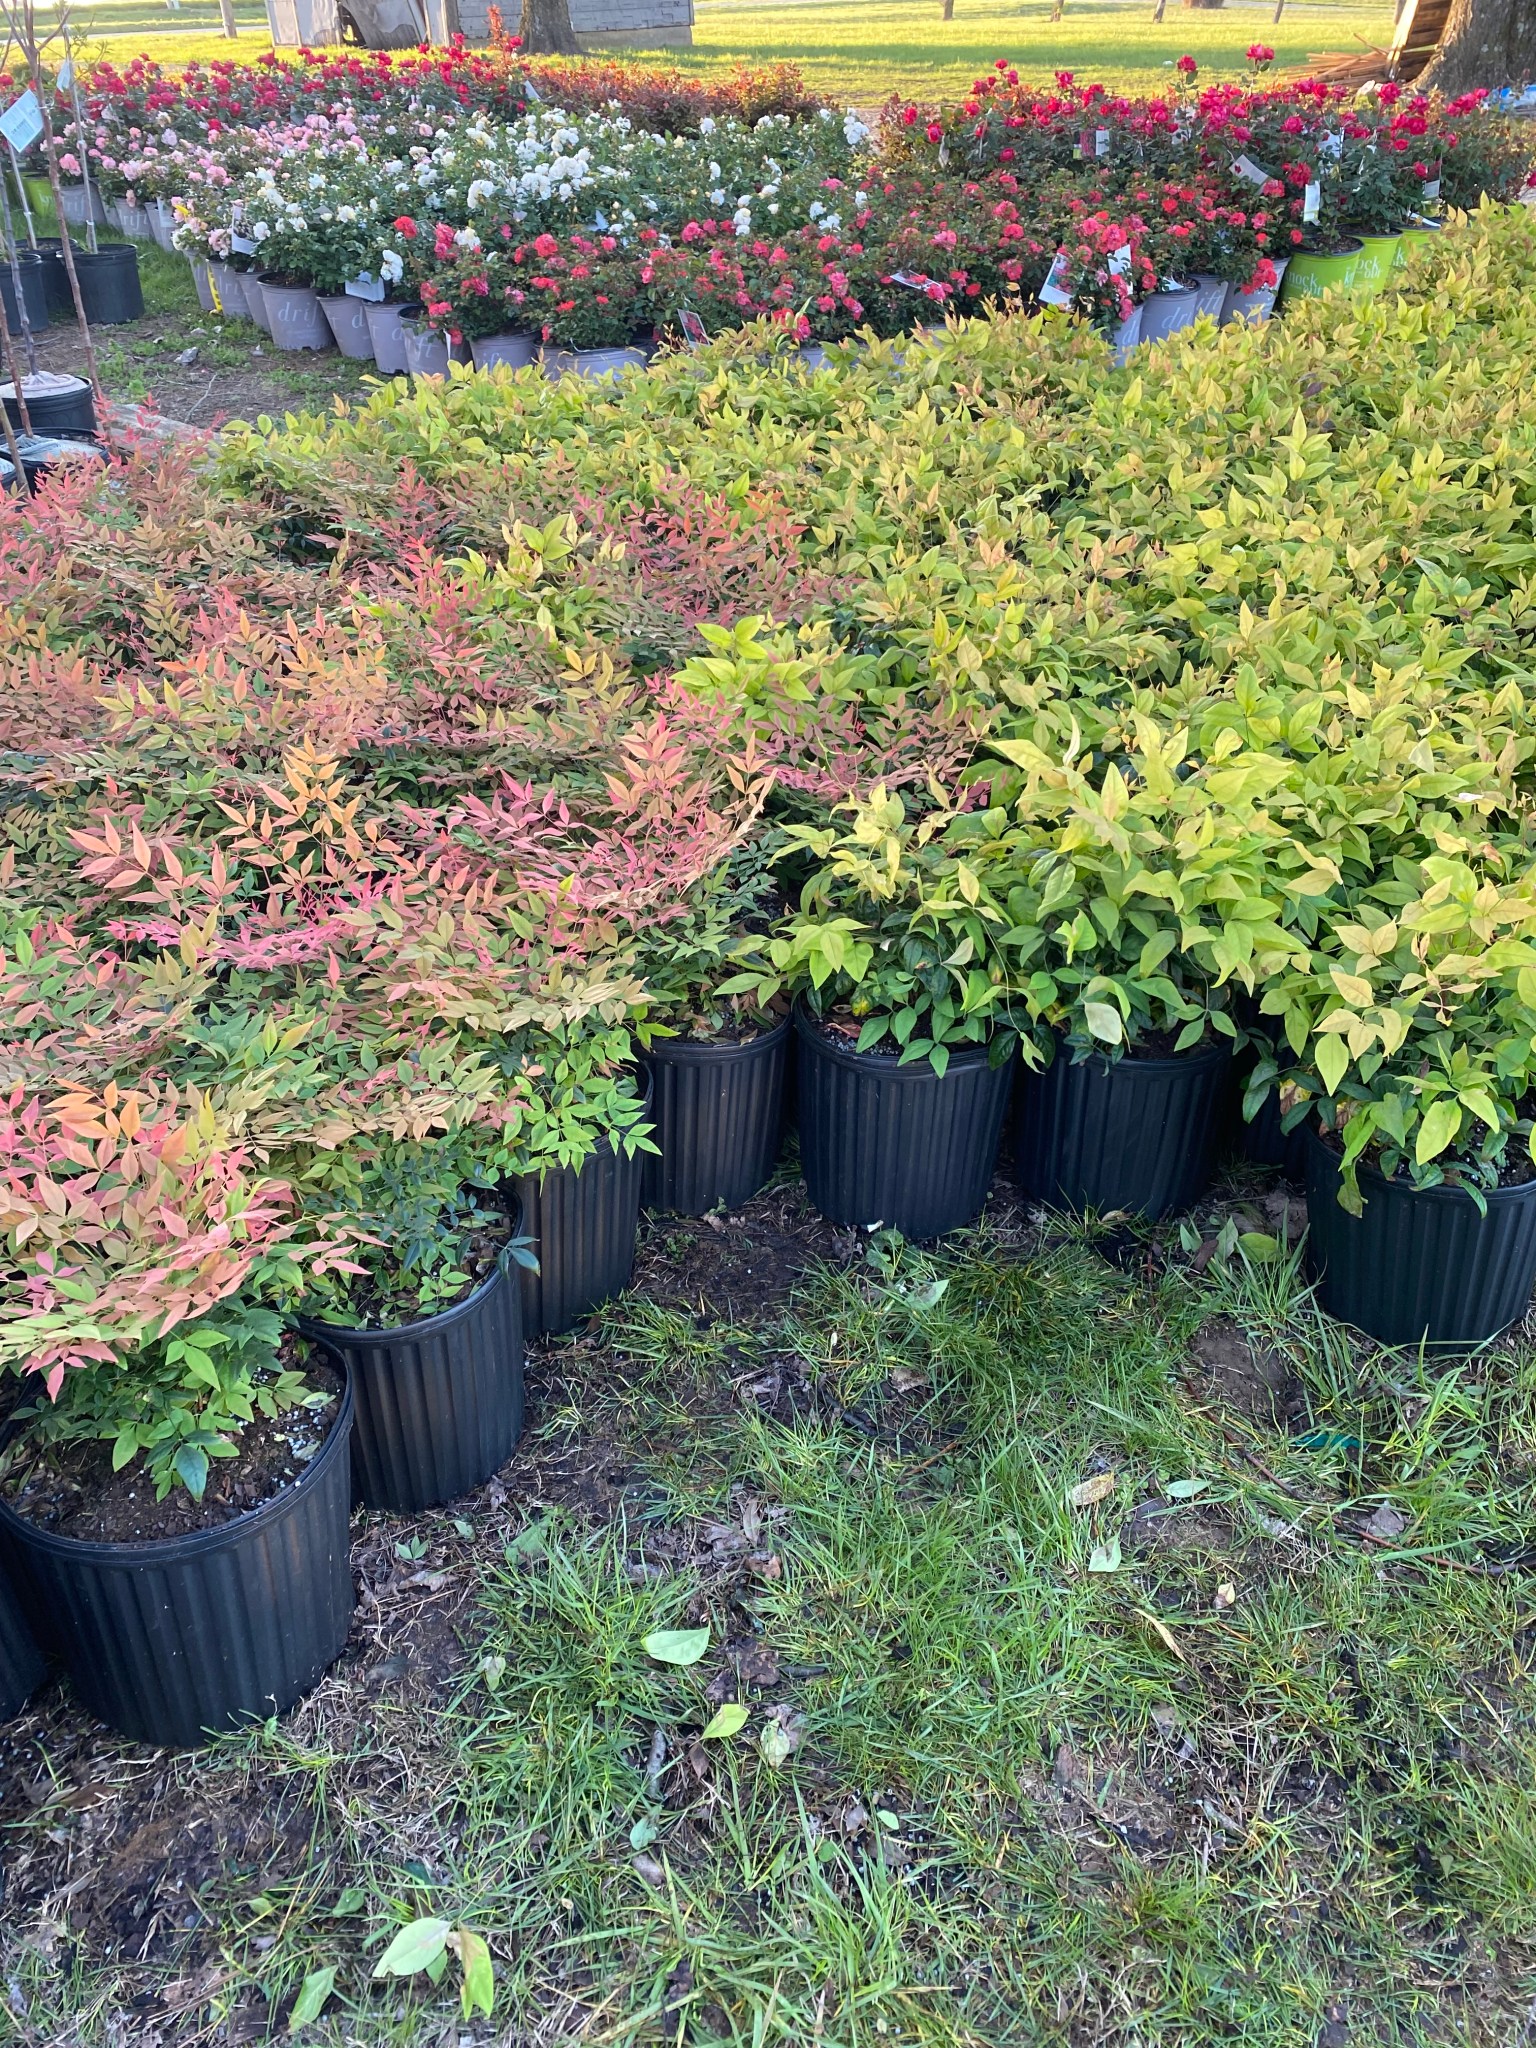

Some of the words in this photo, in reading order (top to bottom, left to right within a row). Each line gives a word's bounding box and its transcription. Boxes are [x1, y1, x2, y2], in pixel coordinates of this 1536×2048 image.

[1357, 255, 1381, 270] ock
[1287, 271, 1320, 288] nock
[1196, 290, 1223, 312] ift
